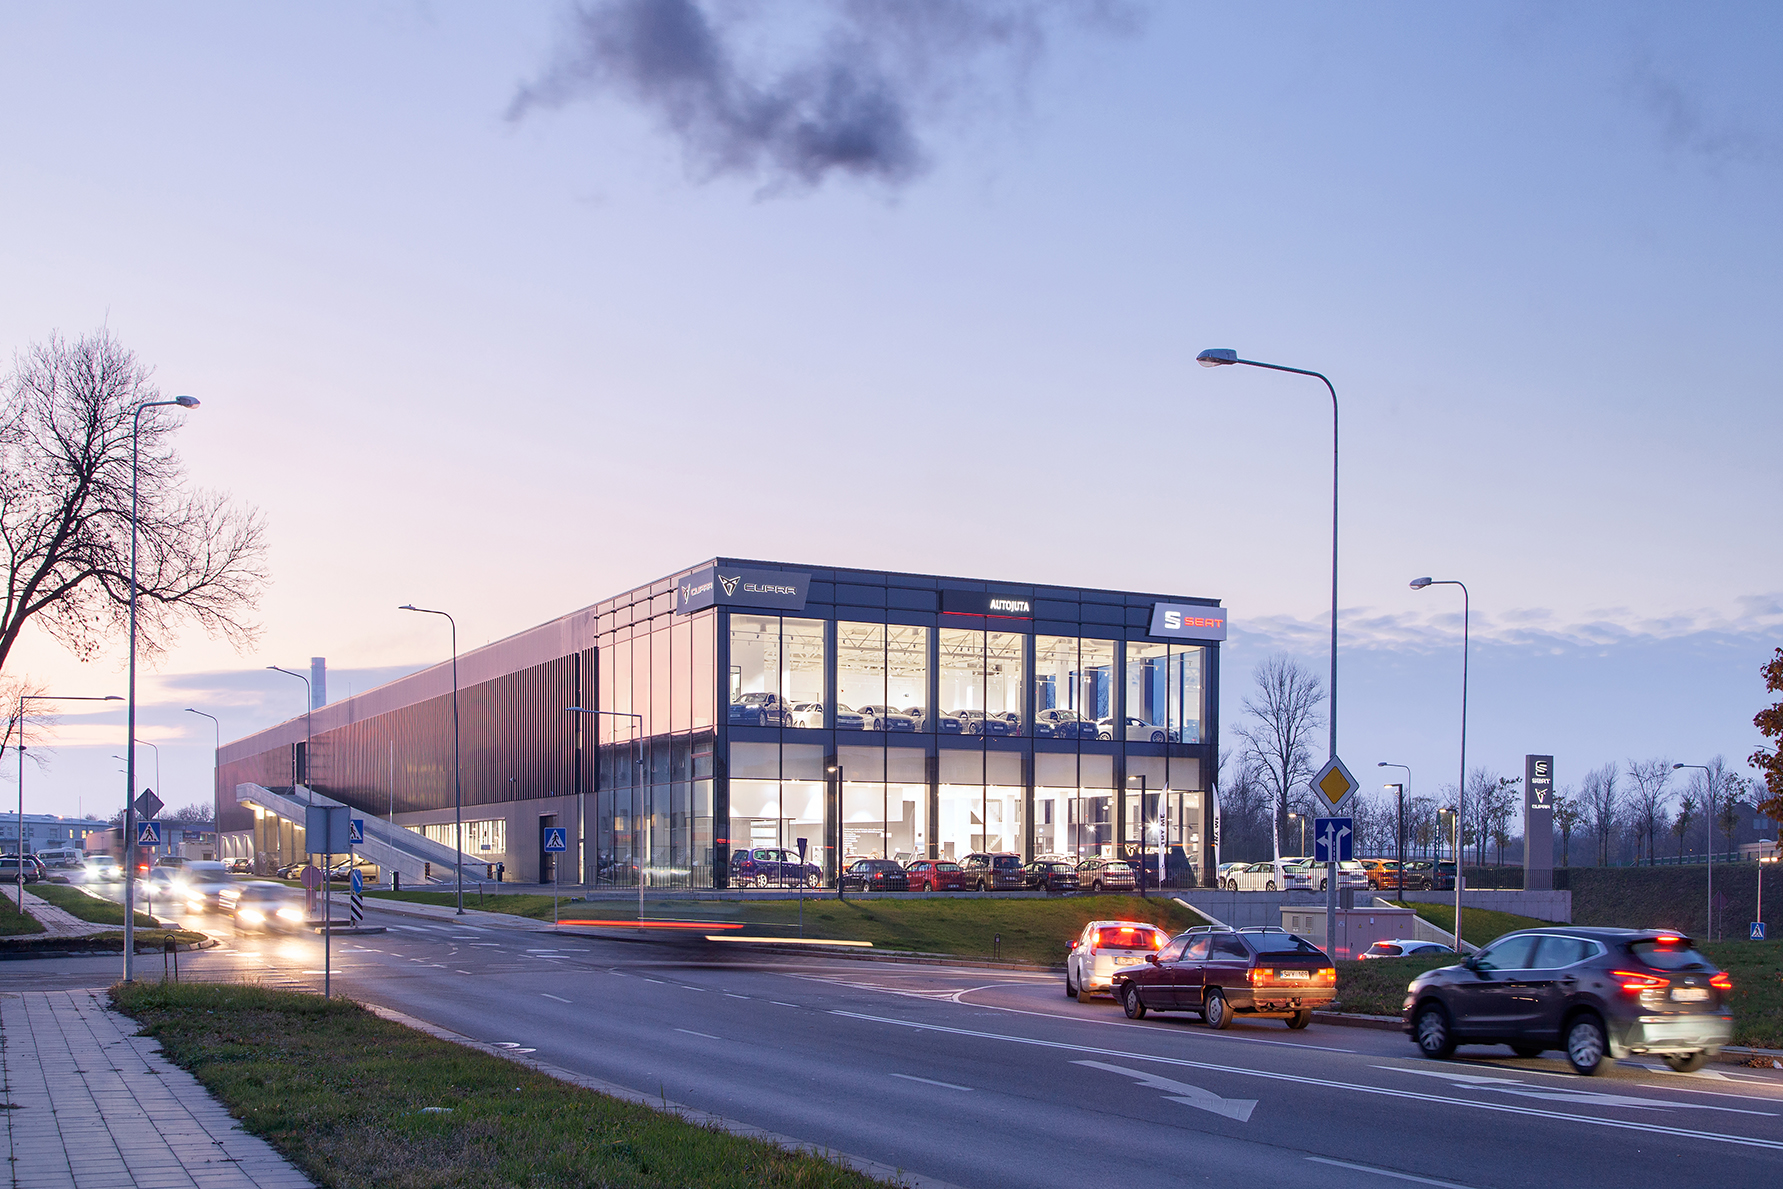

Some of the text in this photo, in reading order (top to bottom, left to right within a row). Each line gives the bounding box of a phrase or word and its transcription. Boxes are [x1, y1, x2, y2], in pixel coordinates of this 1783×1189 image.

[743, 583, 796, 595] CUPRA
[990, 599, 1030, 612] AUTOJUTA
[1184, 616, 1223, 628] SEAT
